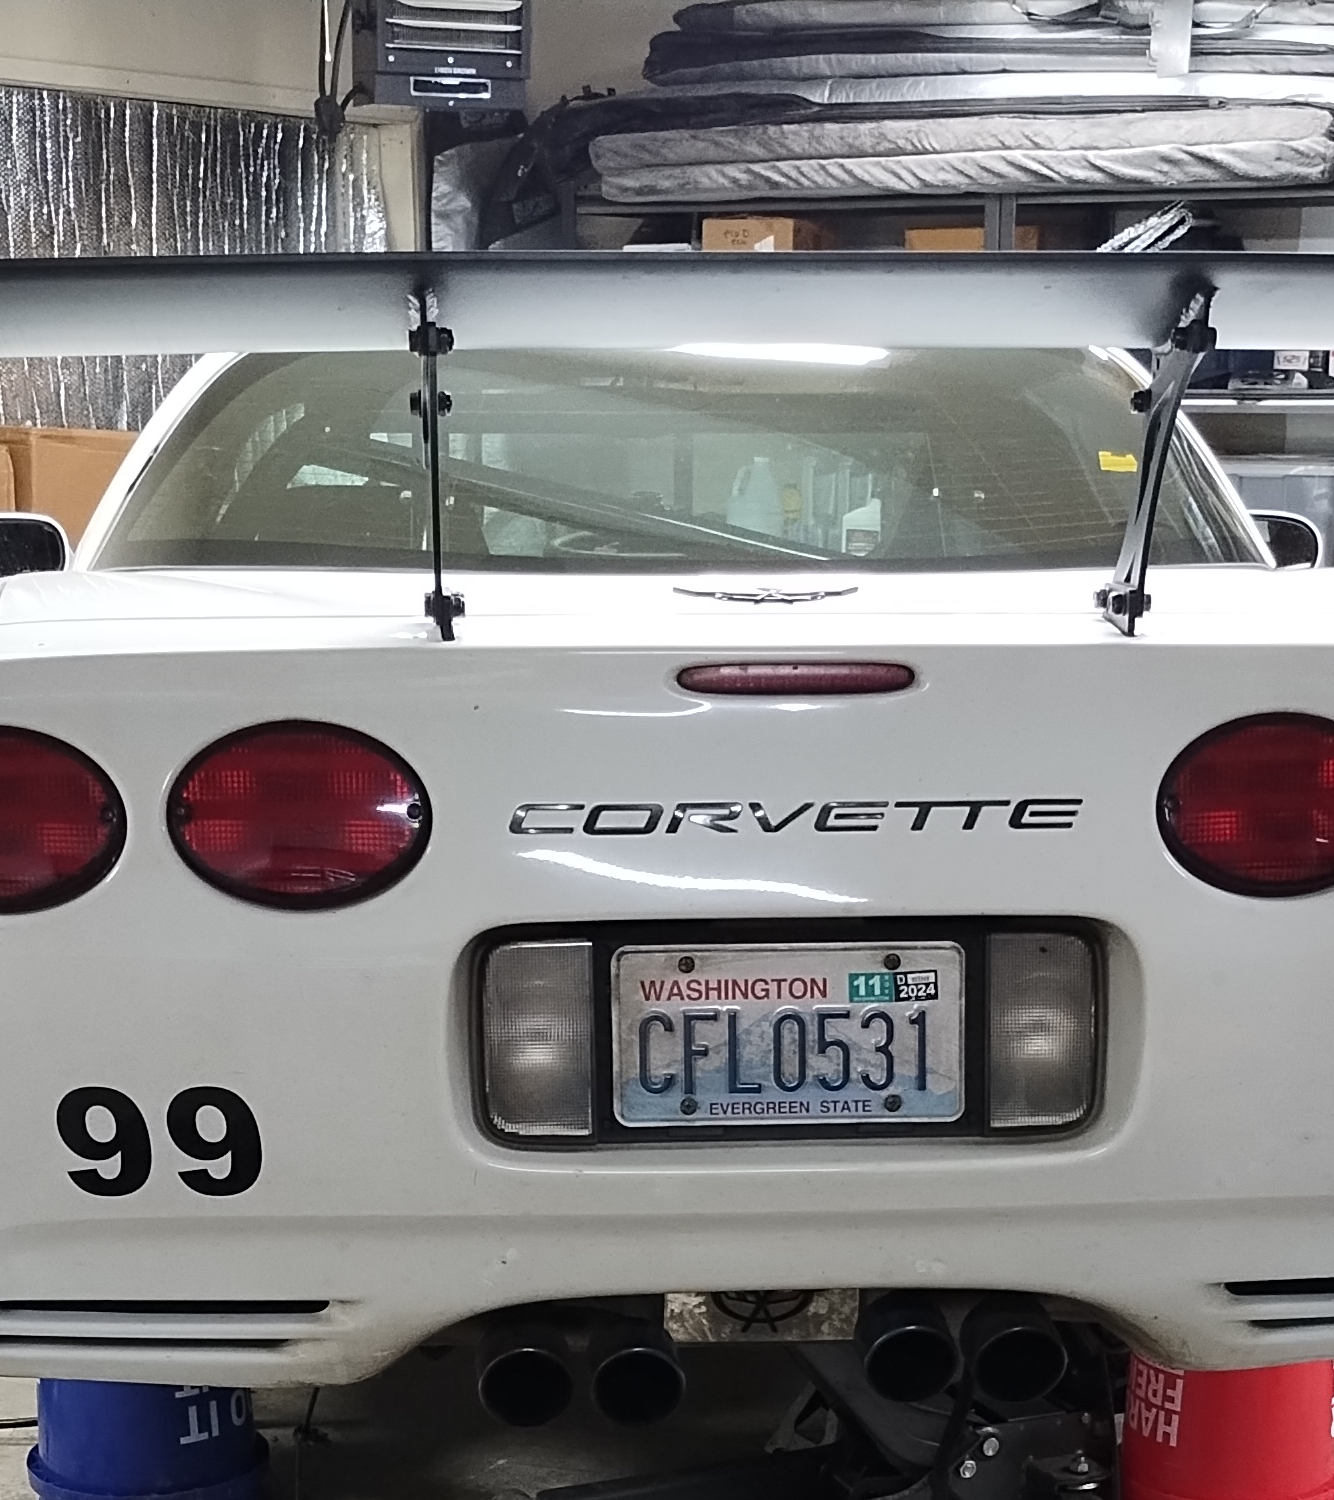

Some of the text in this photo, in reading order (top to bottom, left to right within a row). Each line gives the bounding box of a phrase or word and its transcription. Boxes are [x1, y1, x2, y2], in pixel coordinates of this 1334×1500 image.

[509, 798, 1083, 835] CORVETTE
[640, 977, 828, 1001] WASHINGTON
[853, 975, 881, 996] 11
[897, 975, 906, 985] D
[899, 984, 936, 998] 2024
[638, 1008, 928, 1095] CFL0531
[709, 1100, 873, 1116] EVERGREEN STATE
[56, 1086, 263, 1197] 99
[180, 1400, 220, 1444] IT
